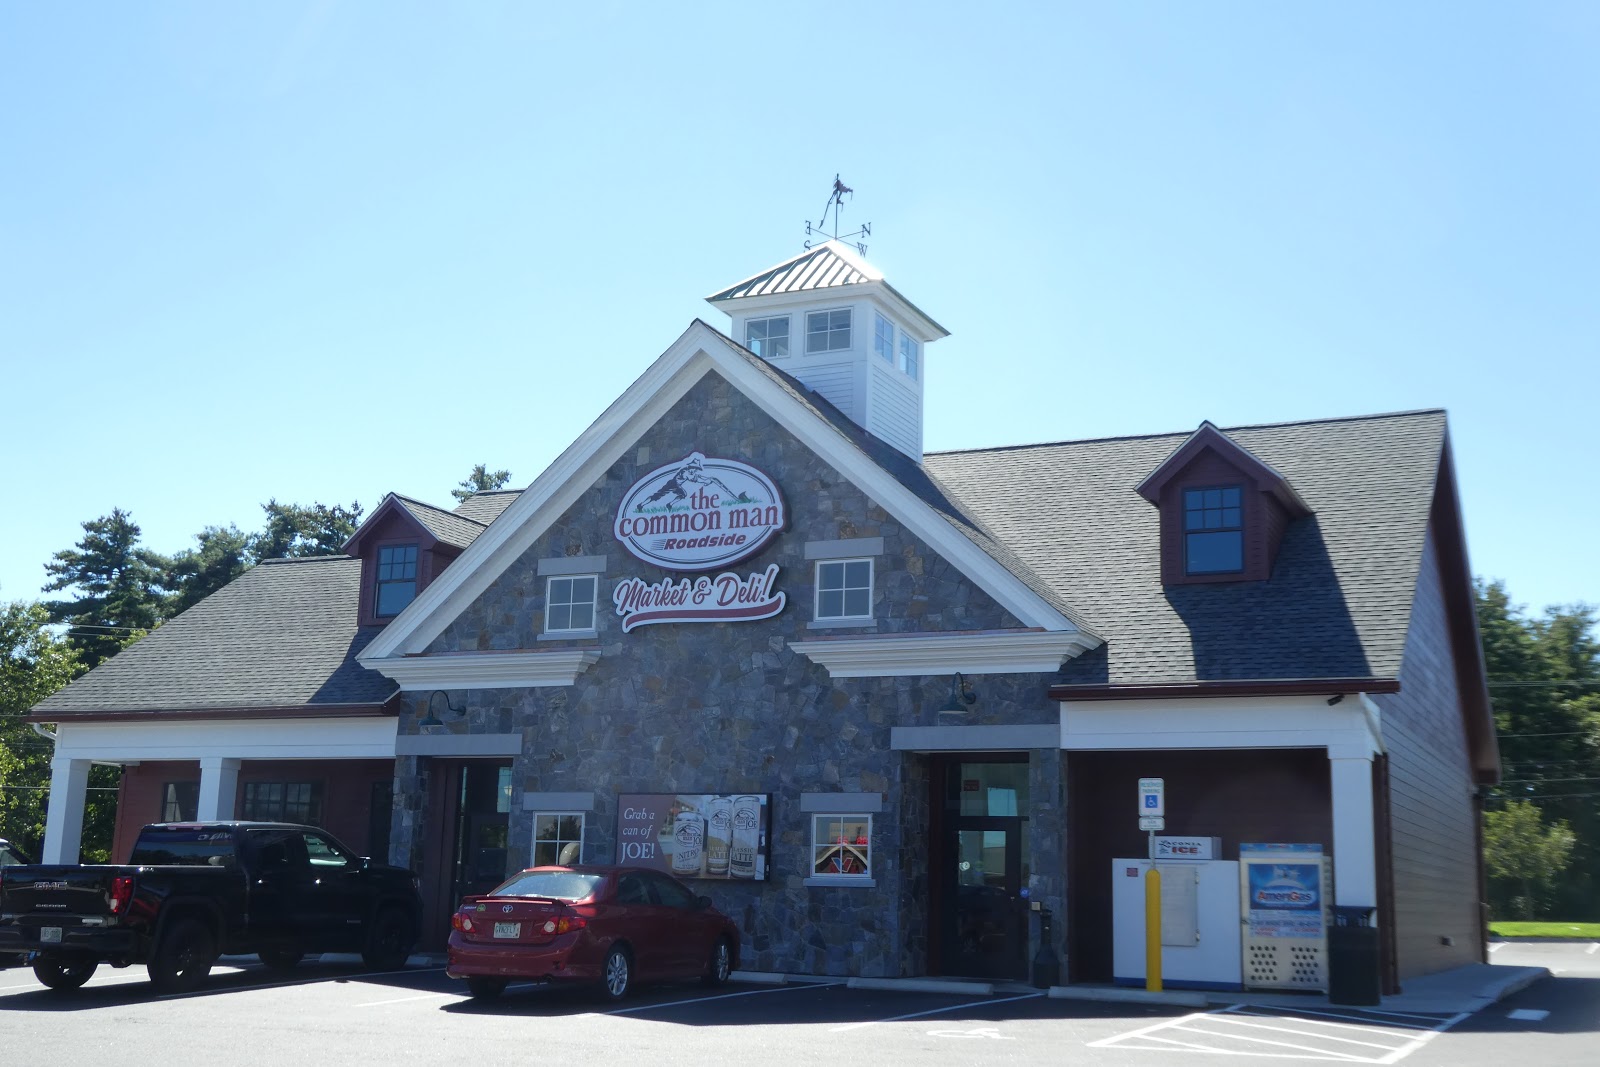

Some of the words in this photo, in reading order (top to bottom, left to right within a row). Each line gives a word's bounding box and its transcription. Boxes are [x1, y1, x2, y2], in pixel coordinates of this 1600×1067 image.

[690, 486, 719, 510] the
[619, 509, 721, 537] common
[729, 505, 778, 529] man
[664, 534, 747, 550] Roadside
[616, 580, 689, 612] Market
[692, 580, 712, 604] &
[716, 568, 776, 607] Deli!
[624, 807, 647, 820] Grab
[649, 812, 655, 820] a
[622, 827, 638, 836] can
[640, 825, 653, 839] of
[620, 842, 655, 864] JOE!
[1257, 891, 1312, 903] AmeriGas
